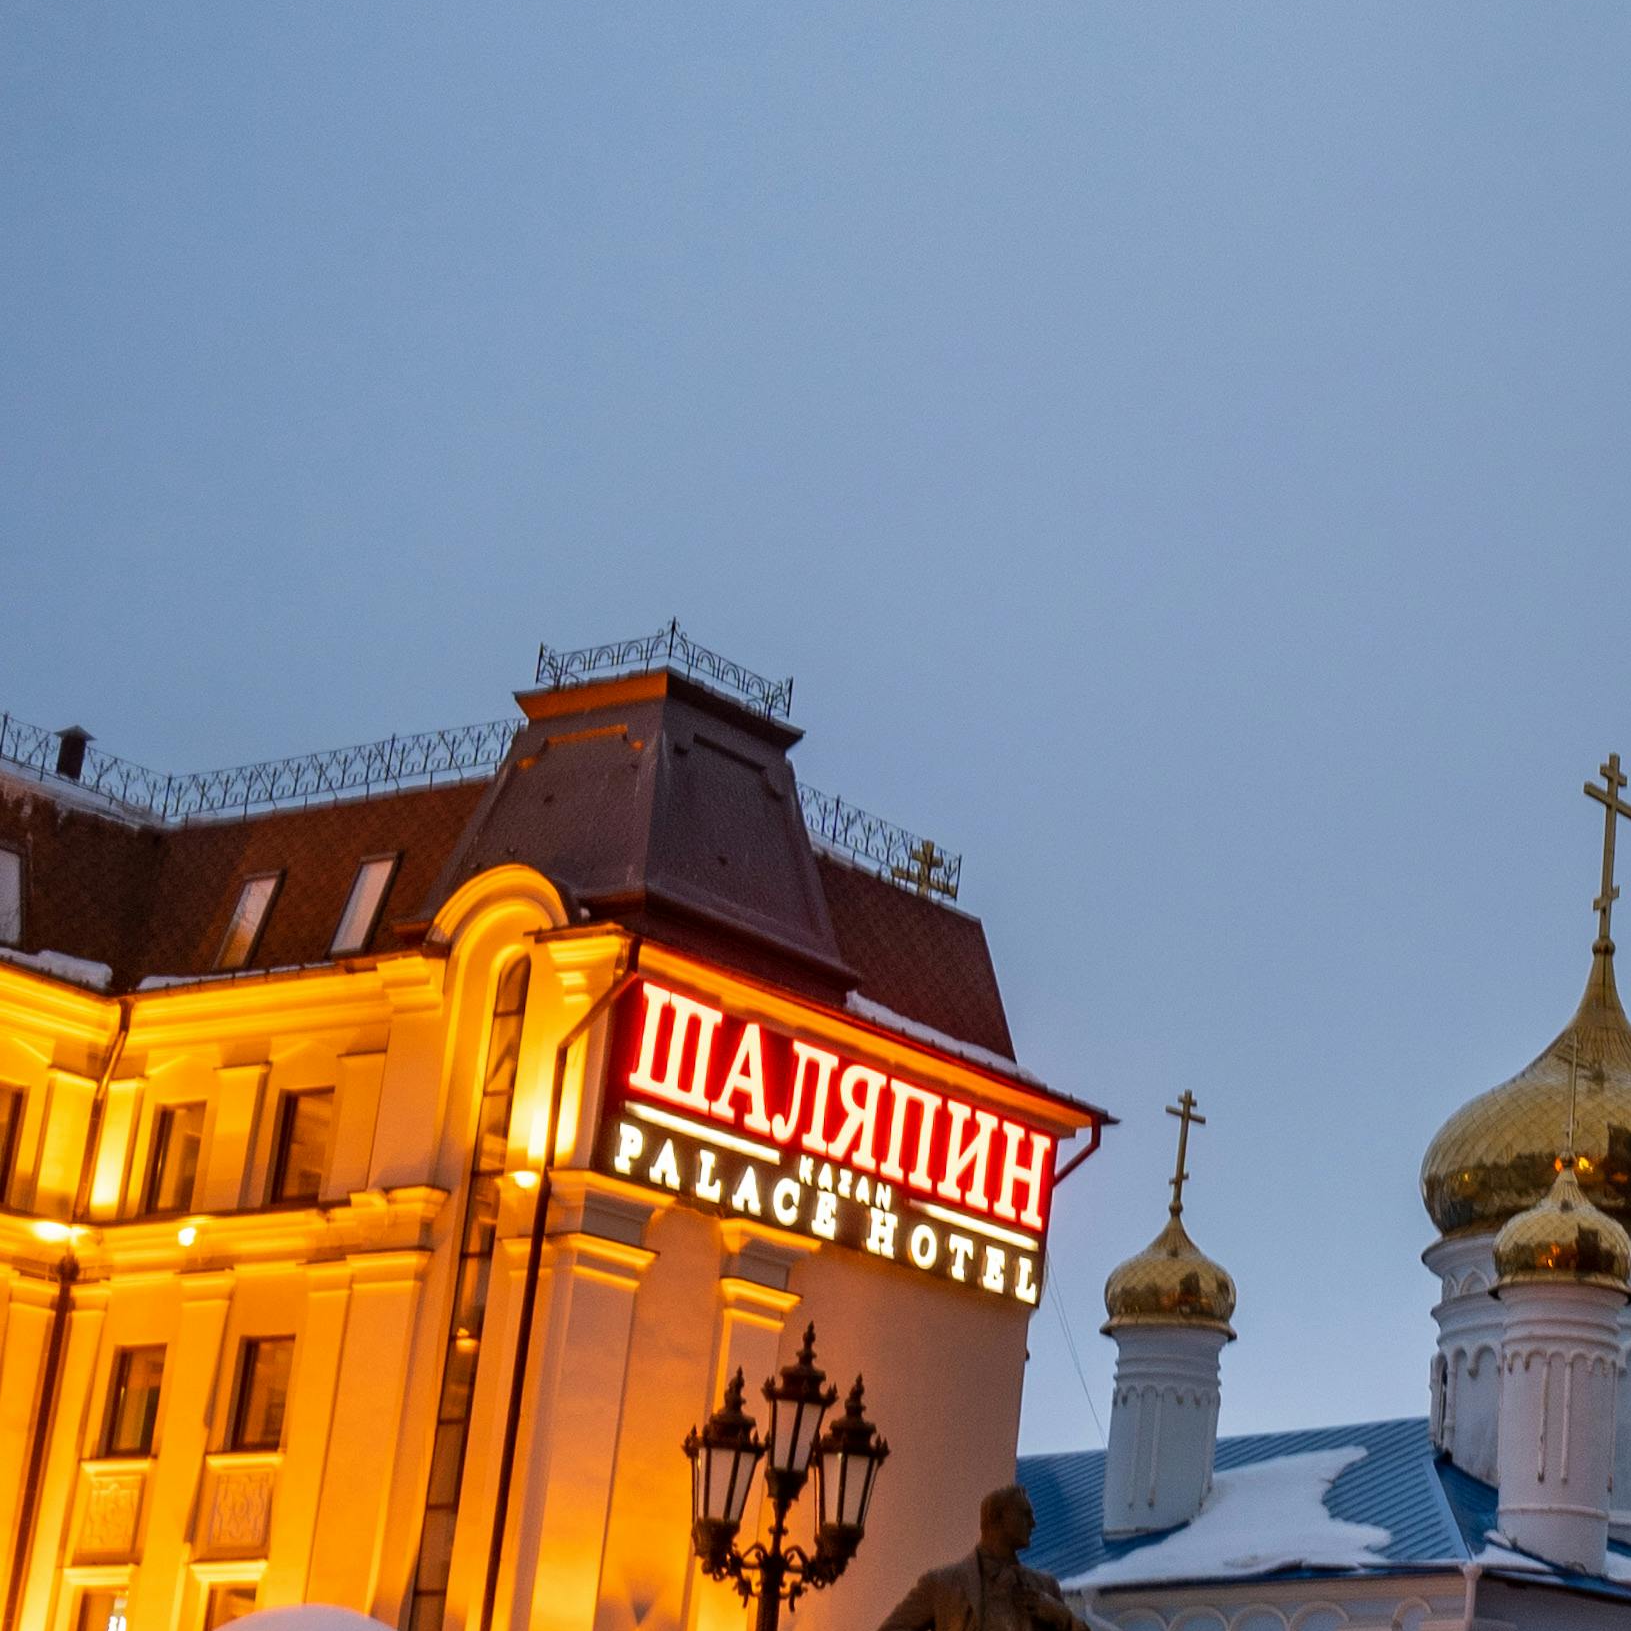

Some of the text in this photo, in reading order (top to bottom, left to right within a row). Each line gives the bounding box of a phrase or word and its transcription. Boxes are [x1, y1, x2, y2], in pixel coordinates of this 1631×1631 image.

[629, 982, 1051, 1230] ШАЛЯПИН
[797, 1155, 892, 1210] KAZAN
[614, 1122, 1038, 1304] PALACE HOTEL
